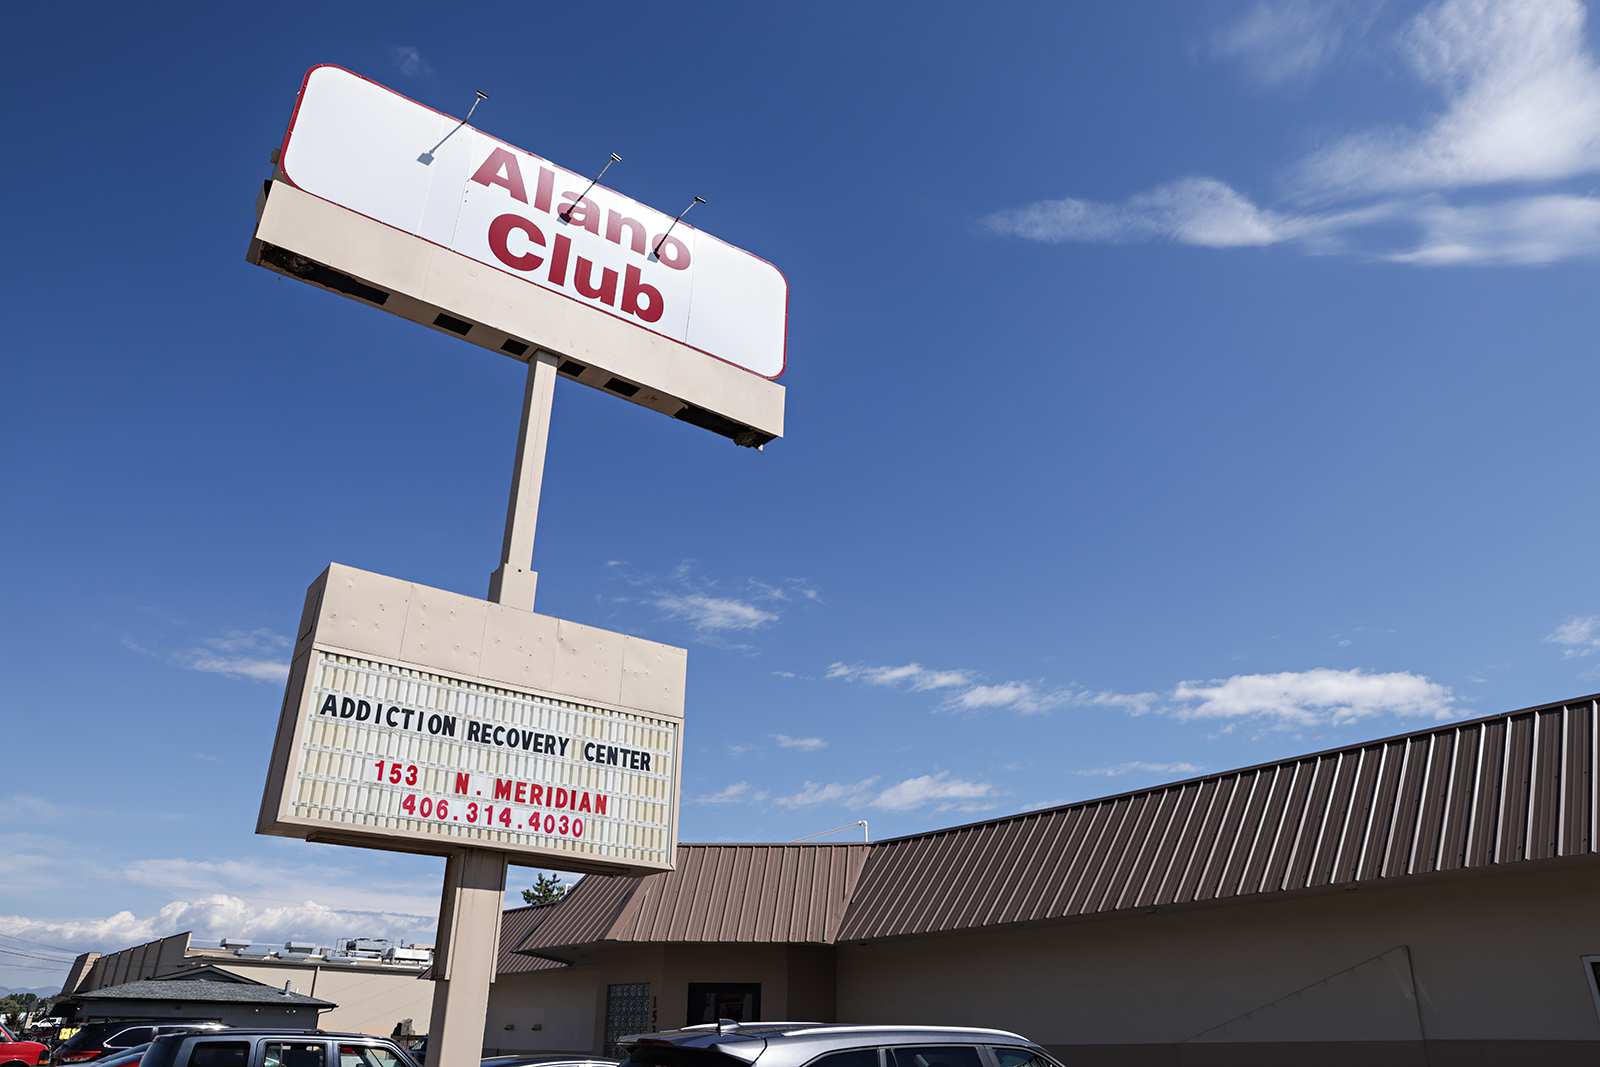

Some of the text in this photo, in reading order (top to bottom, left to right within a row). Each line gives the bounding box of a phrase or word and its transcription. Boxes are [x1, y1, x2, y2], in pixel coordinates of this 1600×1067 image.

[470, 146, 691, 271] Alano
[488, 213, 664, 323] Club
[320, 695, 651, 771] ADDICTION RECOVERY CENTER
[375, 760, 608, 815] 153 N. MERIDIAN
[402, 794, 584, 838] 406.314.4030
